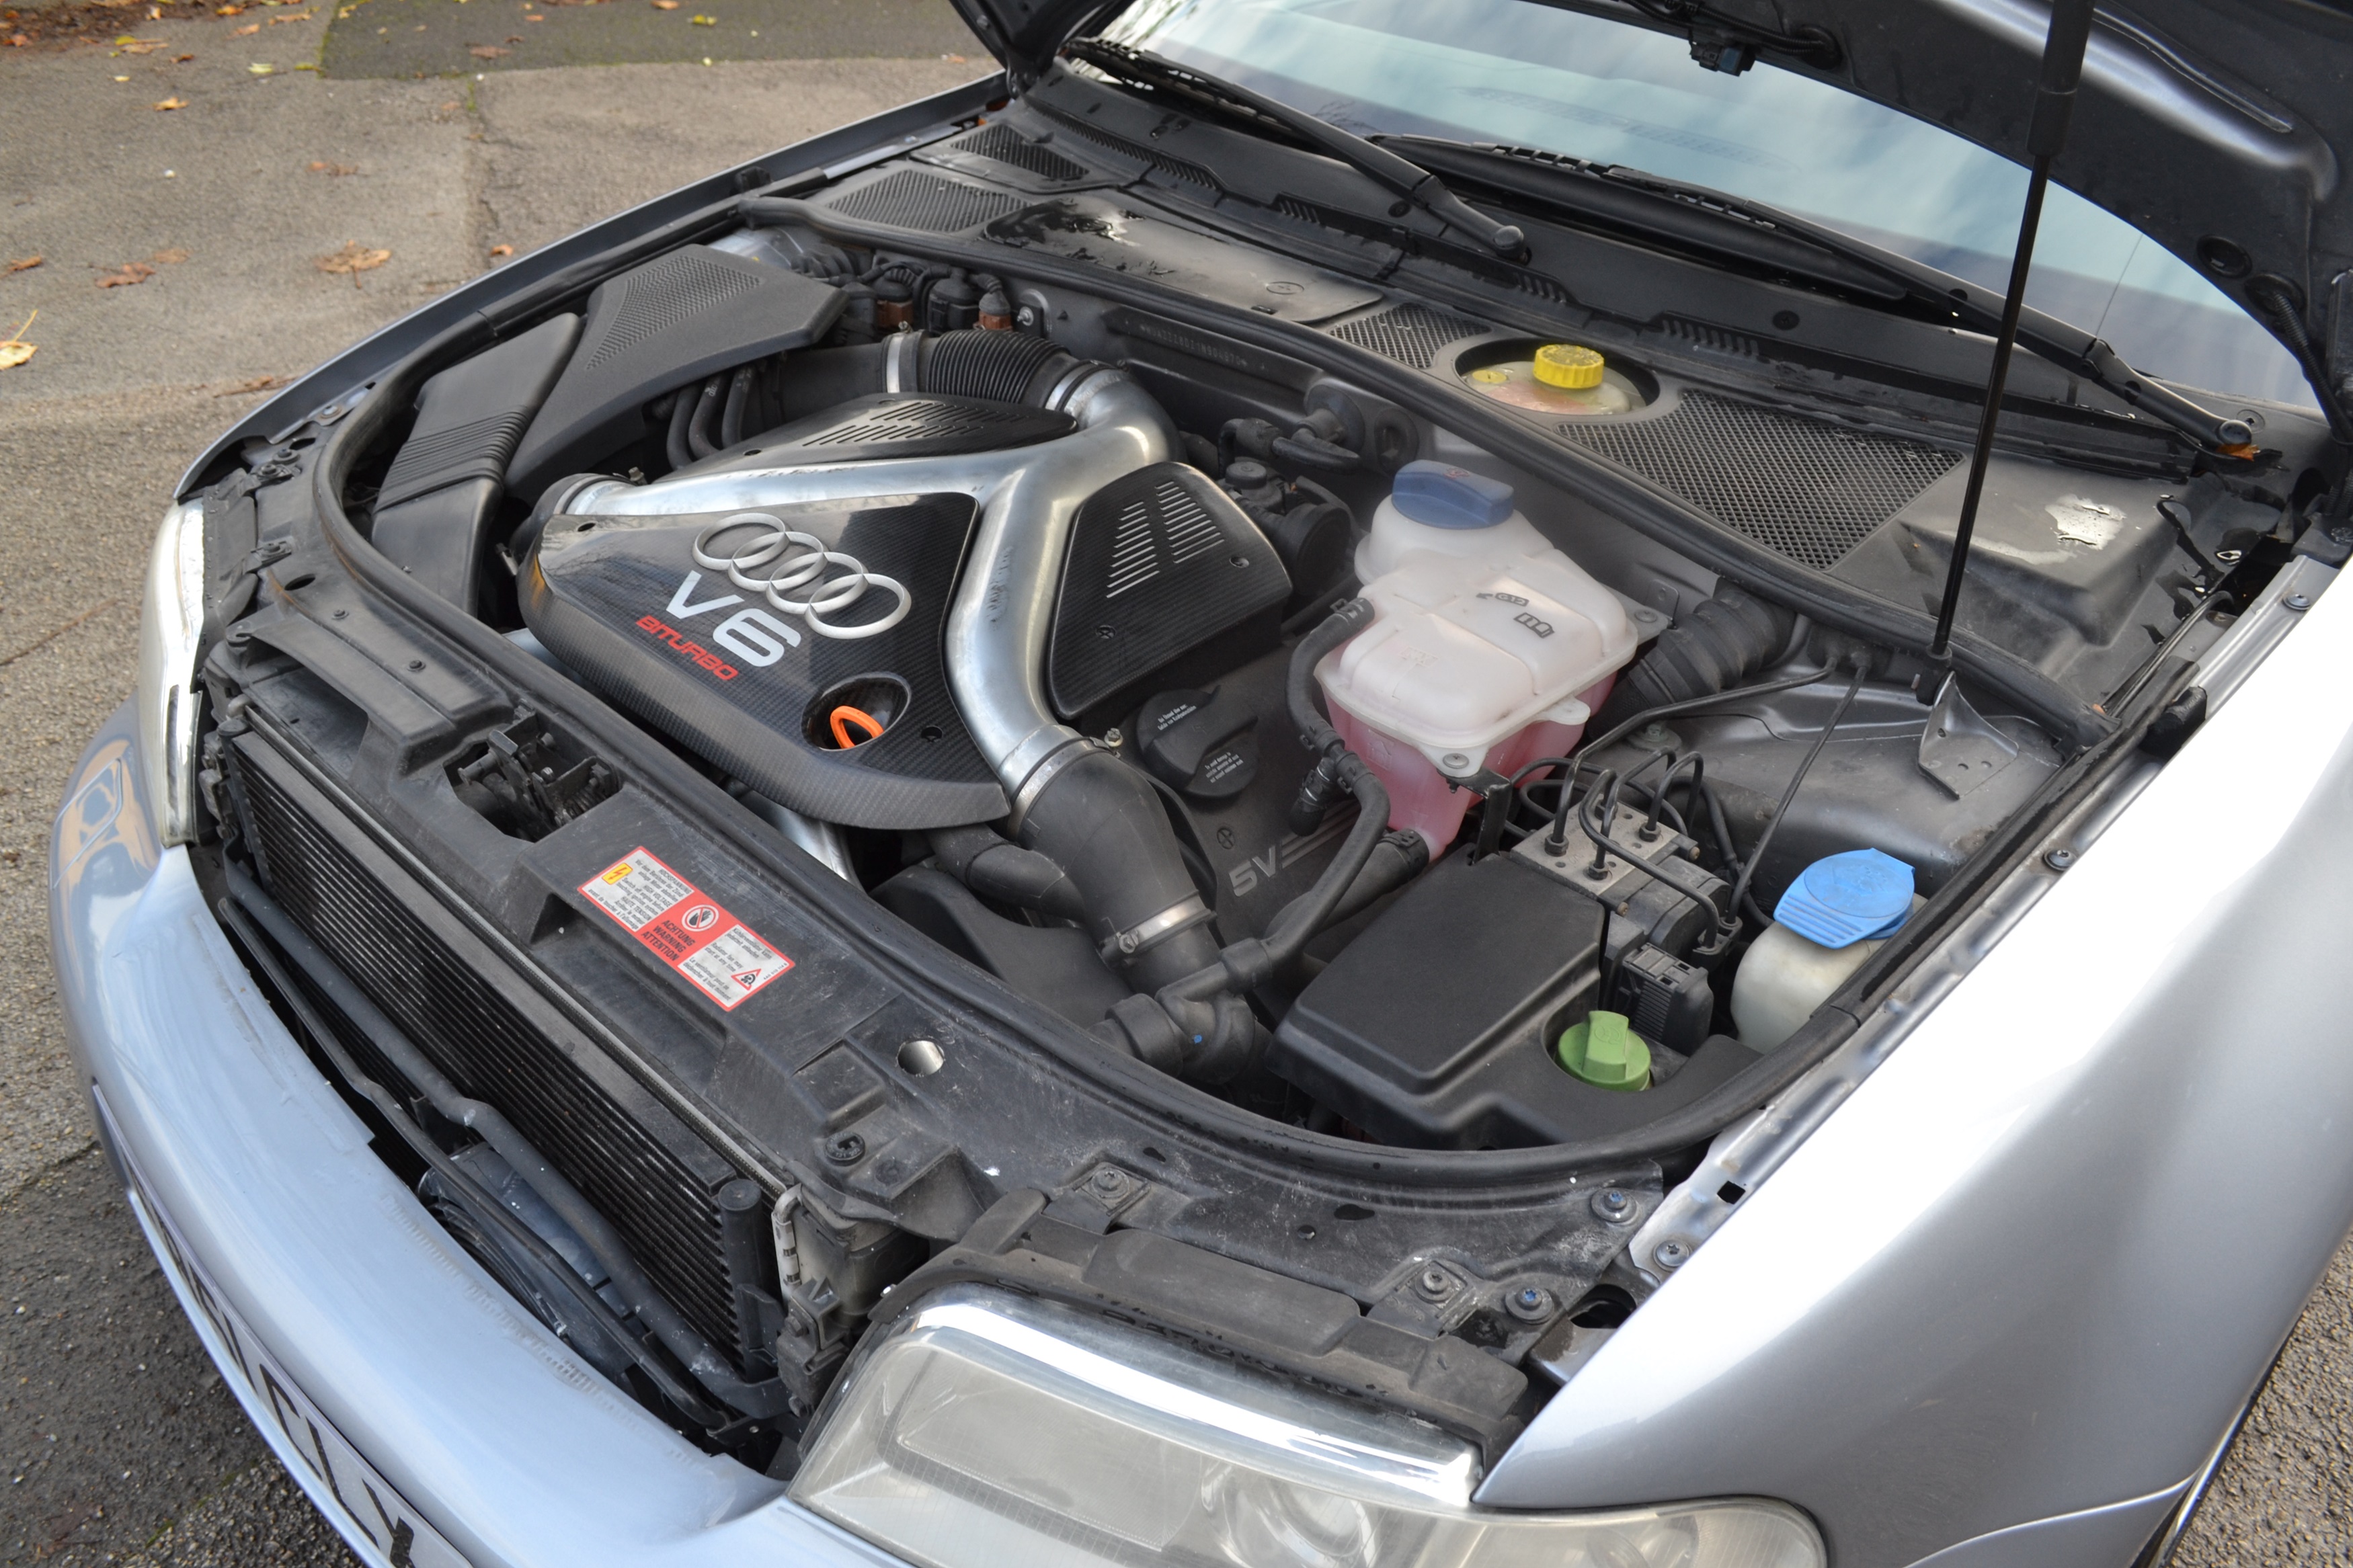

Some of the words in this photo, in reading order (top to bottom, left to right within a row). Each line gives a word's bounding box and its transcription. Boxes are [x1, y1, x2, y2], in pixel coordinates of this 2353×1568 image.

[666, 570, 801, 667] V6
[635, 614, 739, 680] BITURBO
[637, 871, 651, 881] anlage
[650, 880, 662, 889] Motor
[659, 869, 691, 893] HOCHSPANNUNG
[1229, 845, 1276, 897] 5V
[588, 889, 599, 897] avant
[603, 901, 617, 912] toucher
[615, 882, 632, 895] touching
[631, 895, 645, 906] ignition
[644, 905, 657, 916] system
[623, 878, 636, 889] Switch
[639, 892, 653, 903] engine
[652, 901, 665, 911] before
[643, 885, 654, 893] HIGH
[653, 893, 671, 907] VOLTAGE
[621, 896, 635, 907] HAUTE
[633, 906, 651, 920] TENSION
[631, 914, 645, 925] moteur
[652, 926, 686, 952] WARNING
[661, 920, 695, 946] ACHTUNG
[641, 931, 680, 961] ATTENTION
[705, 947, 715, 955] start
[711, 942, 728, 956] Radiator
[742, 945, 760, 958] anlaufen
[683, 962, 705, 979] déclencher
[715, 988, 731, 1000] moment
[694, 962, 716, 979] ventilateur
[713, 978, 724, 986] peut
